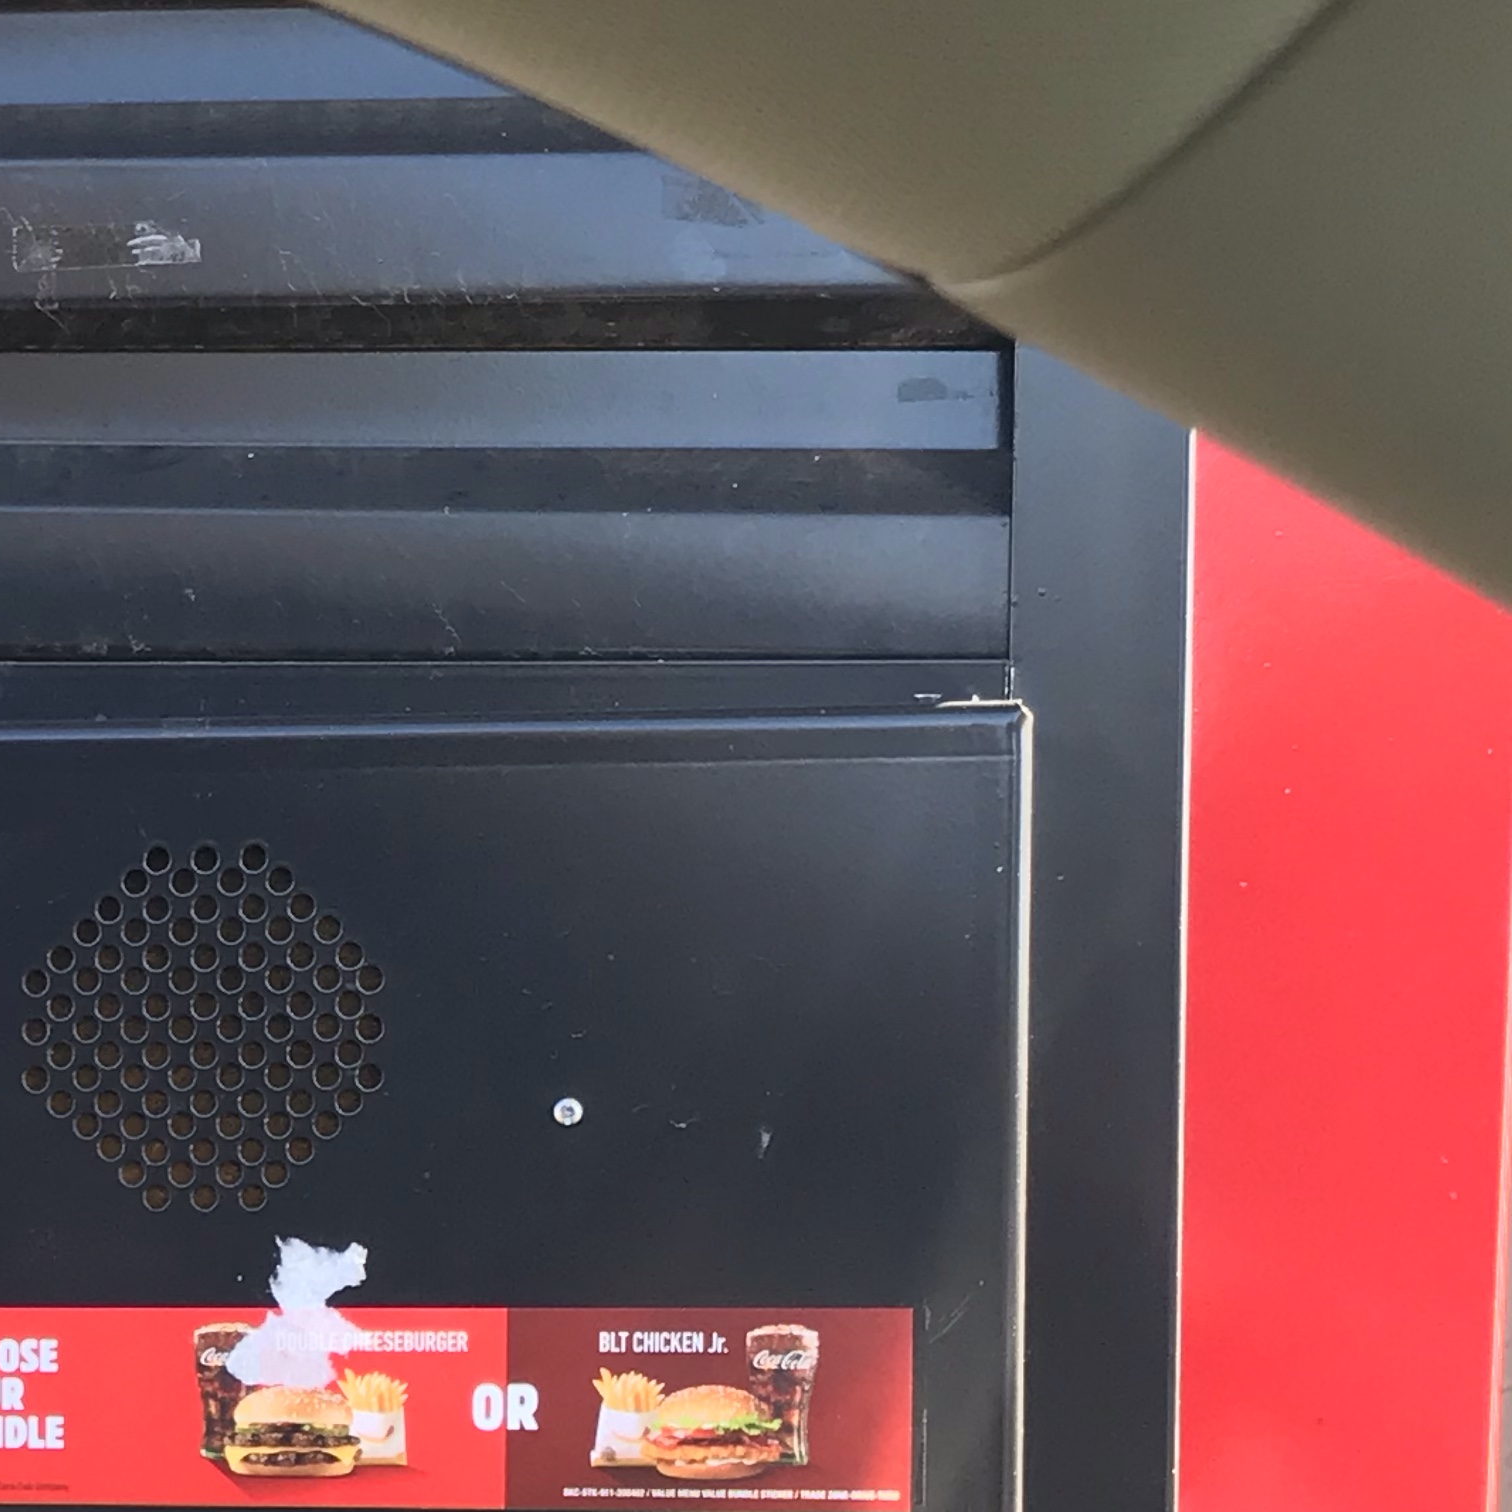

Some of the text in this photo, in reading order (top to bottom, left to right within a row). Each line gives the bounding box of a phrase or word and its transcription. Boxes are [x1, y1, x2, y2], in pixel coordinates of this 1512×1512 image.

[599, 1331, 729, 1354] BLT CHICKEN Jr.
[471, 1382, 539, 1431] OR
